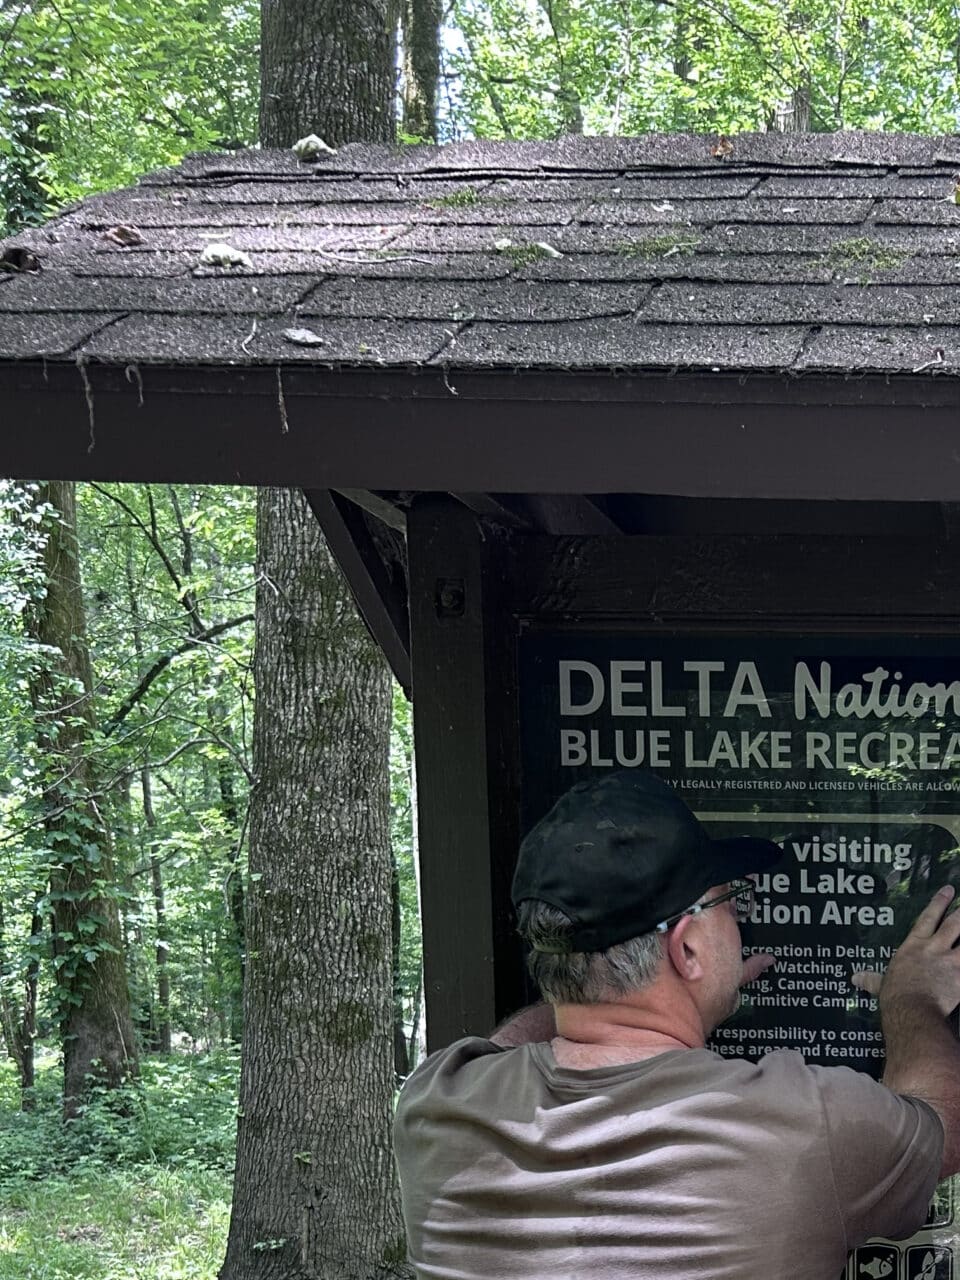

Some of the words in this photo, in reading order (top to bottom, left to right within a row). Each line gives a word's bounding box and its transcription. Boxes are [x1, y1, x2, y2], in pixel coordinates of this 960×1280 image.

[558, 660, 772, 717] DELTA
[560, 729, 671, 767] BLUE
[684, 730, 792, 769] LAKE
[681, 780, 722, 789] LEGALLY
[724, 780, 782, 790] REGISTERED
[785, 781, 807, 790] AND
[809, 781, 855, 791] LICENSED
[857, 782, 903, 791] VEHICLES
[905, 782, 923, 792] ARE
[792, 836, 912, 871] visiting
[800, 868, 875, 894] Lake
[741, 898, 811, 924] tion
[820, 901, 895, 925] Area
[817, 944, 831, 957] in
[835, 945, 875, 958] Delta
[773, 961, 847, 977] Watching,
[778, 978, 850, 994] Canoeing,
[741, 994, 808, 1007] Primitive
[812, 995, 878, 1011] Camping
[716, 1027, 817, 1046] responsibility
[821, 1030, 837, 1041] to
[825, 1045, 886, 1058] features
